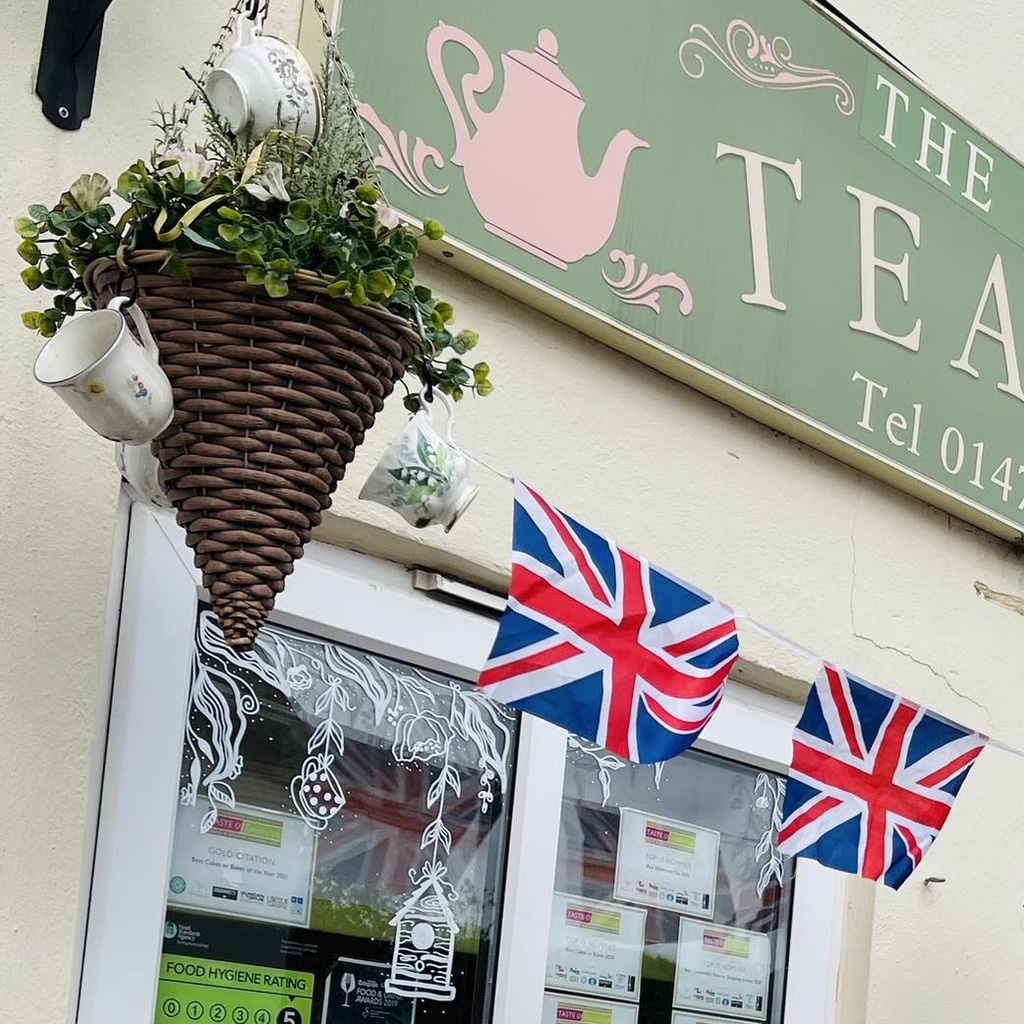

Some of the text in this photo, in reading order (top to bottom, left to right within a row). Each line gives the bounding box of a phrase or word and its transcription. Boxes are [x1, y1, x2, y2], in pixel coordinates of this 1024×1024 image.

[874, 74, 995, 212] THE
[851, 371, 922, 457] Tel
[215, 819, 233, 829] ASTE
[208, 847, 276, 866] GOLD CITATION
[567, 909, 584, 921] TASTE
[166, 961, 306, 991] FOOD HYGIENE RATING
[356, 988, 377, 997] FOOD
[377, 990, 383, 998] &
[355, 995, 399, 1007] AWARDS 2019
[168, 1002, 176, 1013] 0
[192, 1005, 197, 1016] 1
[214, 1007, 222, 1018] 2
[236, 1010, 244, 1021] 3
[258, 1012, 266, 1024] 4
[557, 1009, 576, 1020] TASTE
